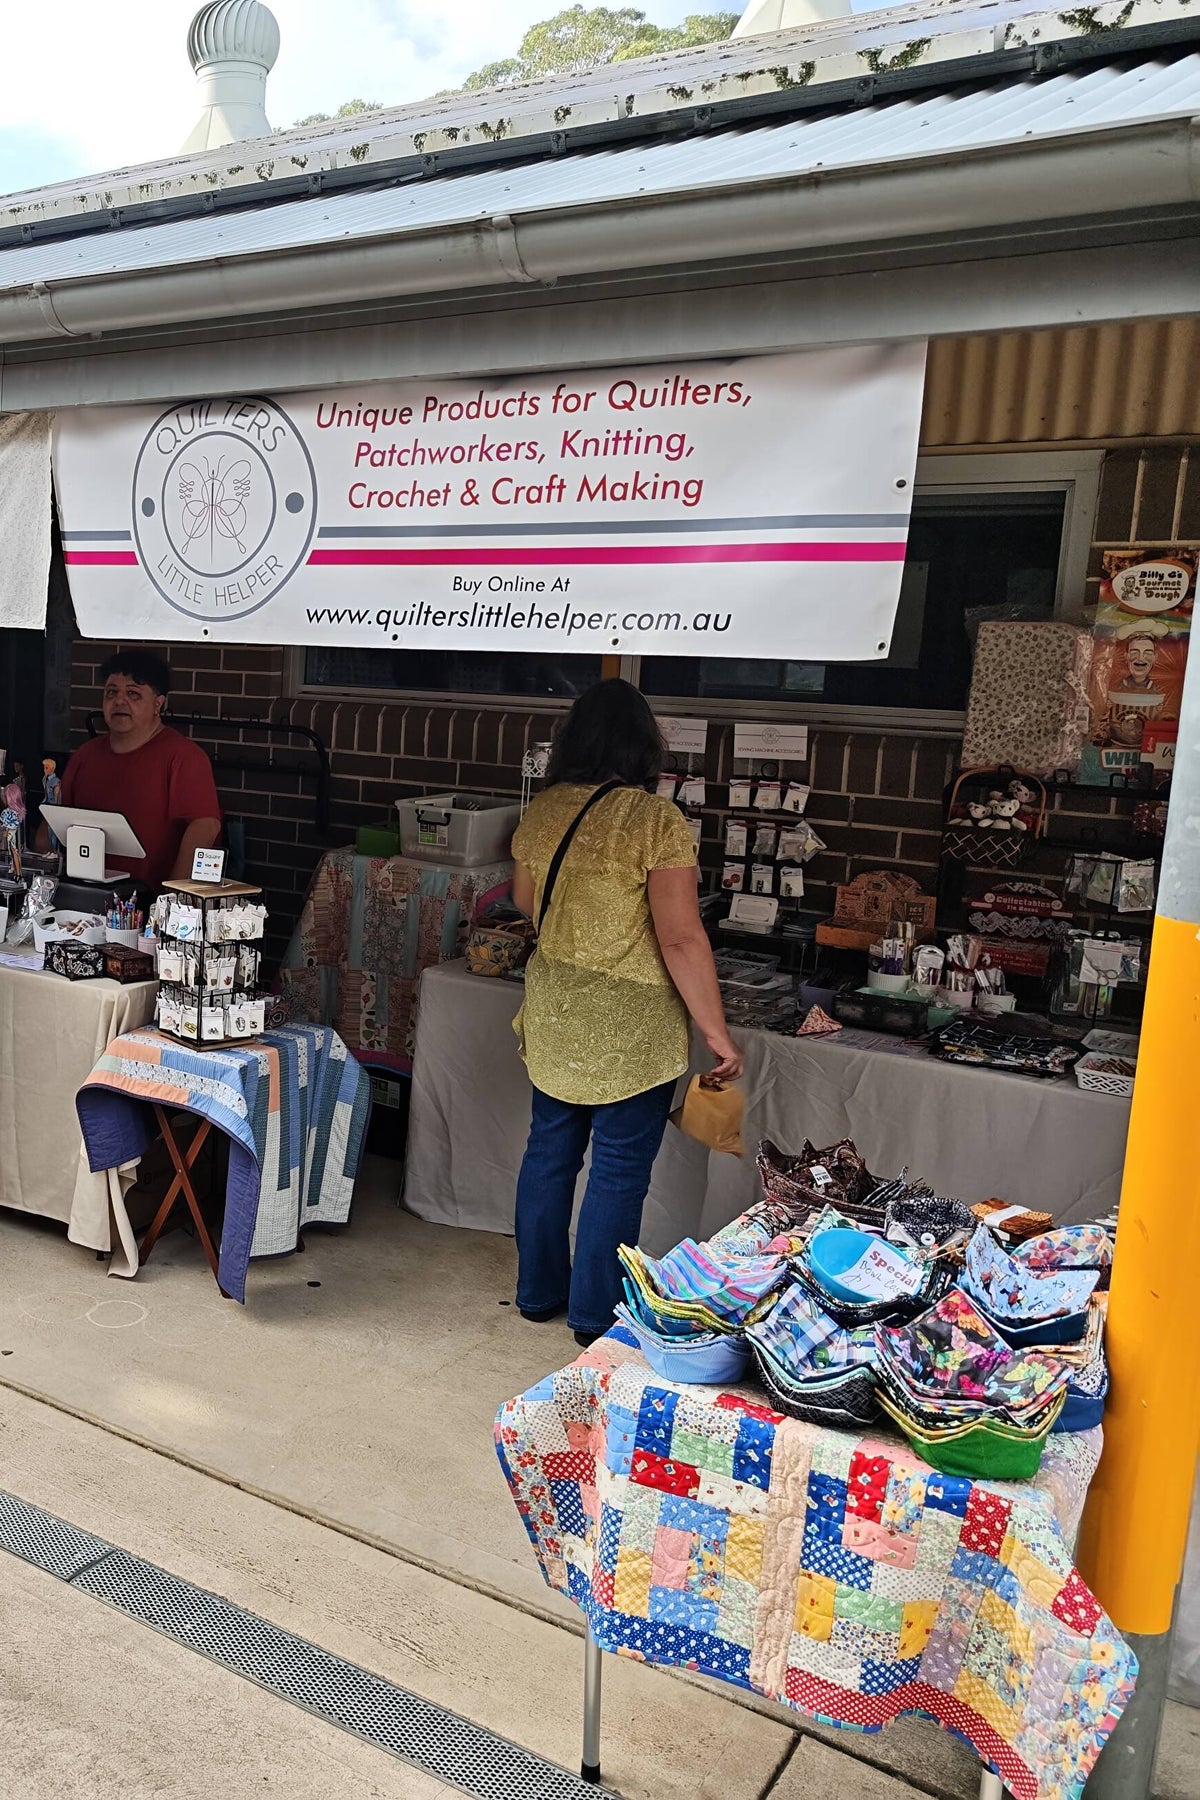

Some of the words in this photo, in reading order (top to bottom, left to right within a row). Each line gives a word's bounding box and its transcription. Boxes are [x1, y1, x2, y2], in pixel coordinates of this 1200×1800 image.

[315, 401, 413, 434] Unique
[422, 389, 541, 423] Products
[551, 383, 597, 414] for
[607, 374, 752, 412] Quilters,
[156, 400, 286, 455] QUILTERS
[354, 433, 546, 468] Patchworkers,
[560, 427, 695, 462] Knitting,
[348, 479, 452, 509] Crochet
[459, 478, 481, 507] &
[491, 473, 567, 506] Craft
[575, 470, 704, 508] Making
[157, 554, 204, 604] LITTLE
[214, 554, 284, 606] HELPER
[452, 576, 482, 595] Buy
[487, 575, 546, 593] Online
[551, 576, 571, 593] At
[1139, 570, 1164, 581] Billy
[1167, 570, 1183, 579] G's
[1144, 590, 1180, 602] Dough
[305, 600, 732, 636] www.quilterslittlehelper.com.au
[995, 895, 1051, 909] Collectables
[869, 1250, 917, 1288] Special
